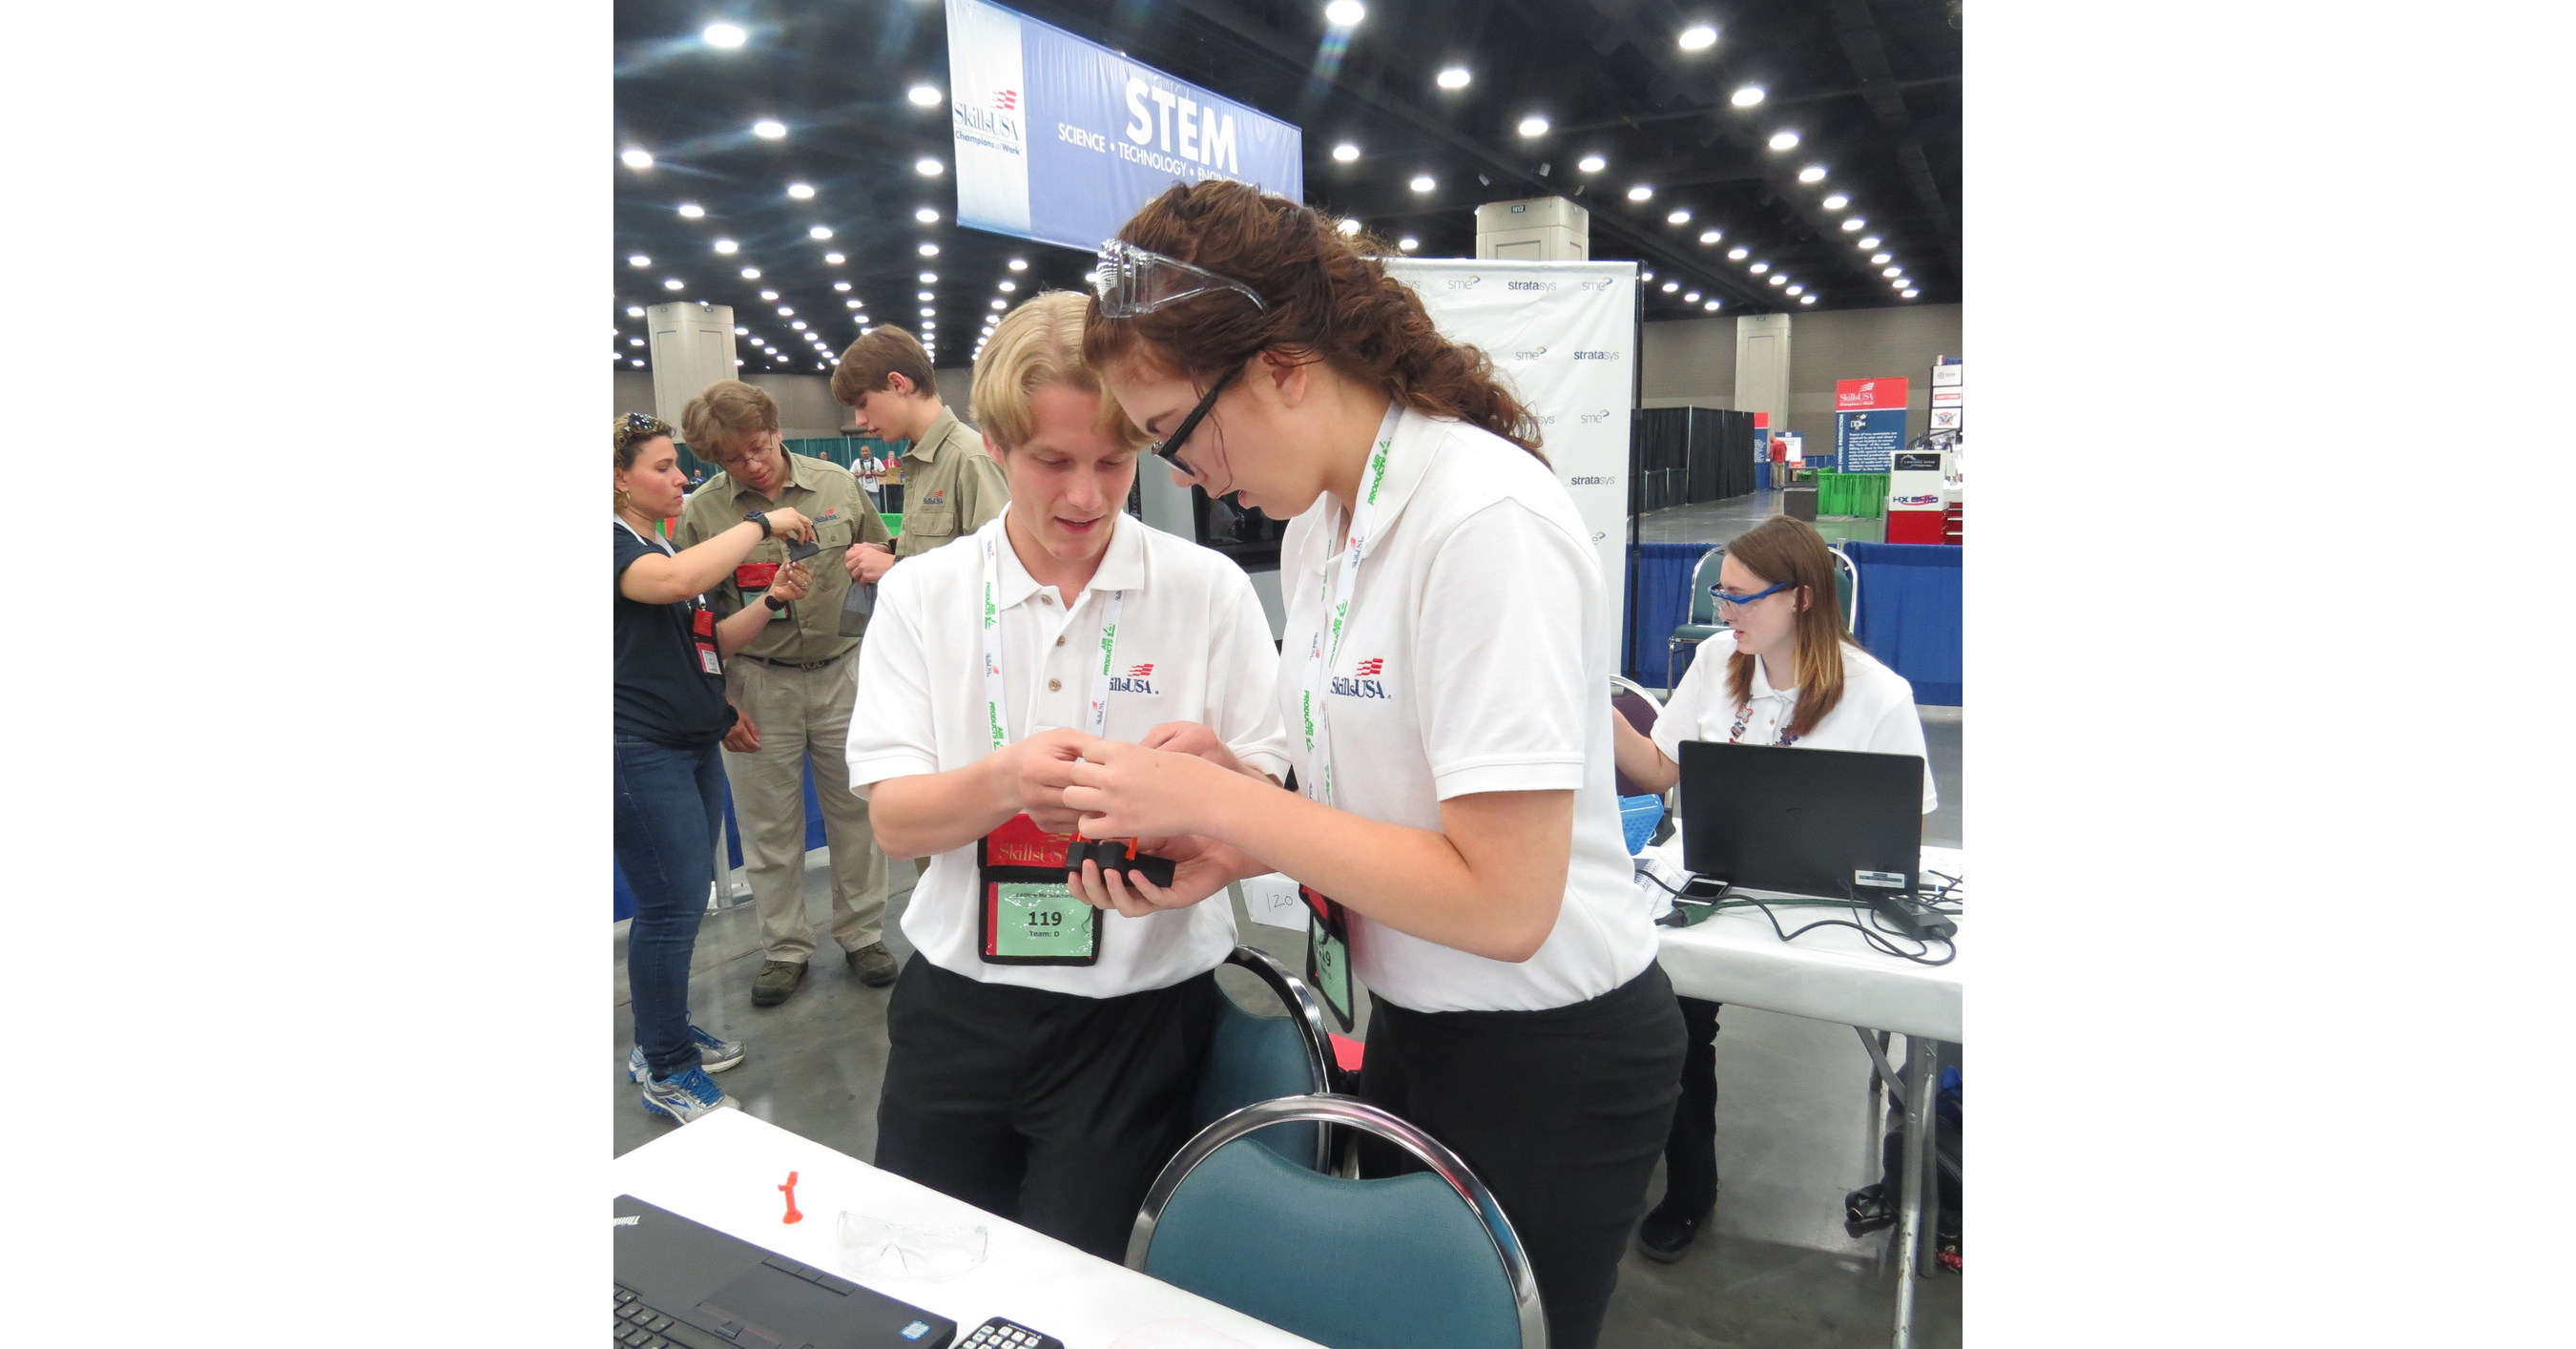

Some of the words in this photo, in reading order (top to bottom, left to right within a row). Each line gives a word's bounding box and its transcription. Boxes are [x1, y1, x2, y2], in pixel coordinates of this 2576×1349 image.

[954, 102, 1019, 141] SkillsUSA
[1126, 76, 1238, 176] STEM
[955, 130, 995, 149] Champions
[1002, 142, 1021, 156] Work
[1058, 122, 1106, 154] SCIENCE
[1118, 141, 1188, 176] TECHNOLOGY
[1447, 280, 1472, 290] sme
[1507, 280, 1557, 293] stratasys
[1581, 281, 1606, 292] sme
[1515, 351, 1540, 361] sme
[1573, 350, 1620, 362] stratasys
[1580, 414, 1603, 424] sme
[1372, 453, 1382, 471] AIR
[1367, 456, 1386, 506] PRODUCTS
[1570, 476, 1615, 486] stratasys
[1103, 638, 1113, 676] PRODUCTS
[1109, 677, 1153, 695] illsUSA
[1330, 675, 1384, 699] SkillsUSA
[988, 701, 998, 740] PRODUCTS
[998, 843, 1067, 863] SkillsUS
[1266, 892, 1294, 913] 120
[1028, 911, 1063, 926] 119
